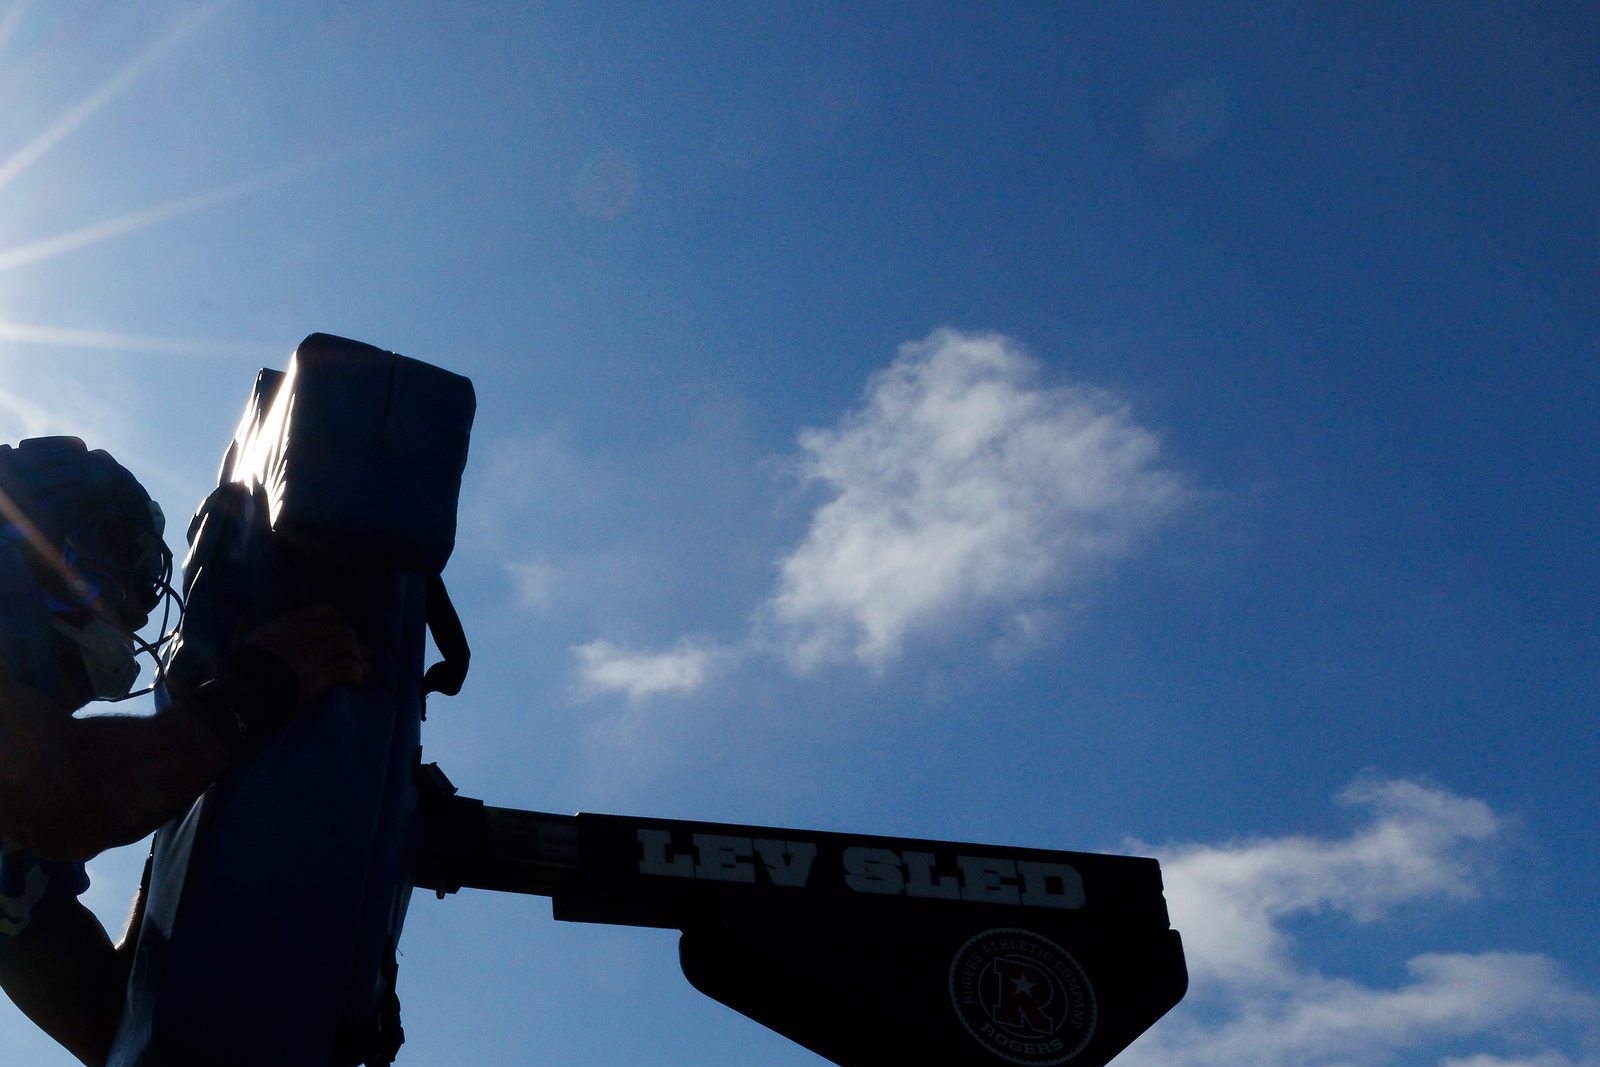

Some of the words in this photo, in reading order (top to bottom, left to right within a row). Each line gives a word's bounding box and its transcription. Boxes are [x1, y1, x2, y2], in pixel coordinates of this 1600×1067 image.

[636, 827, 818, 888] LEV
[840, 845, 1088, 912] SLED
[960, 950, 984, 1005] ROGERS
[981, 938, 1056, 963] ATHLETIC
[1054, 960, 1088, 1032] COMPANY
[979, 1021, 1065, 1056] ROGERS
